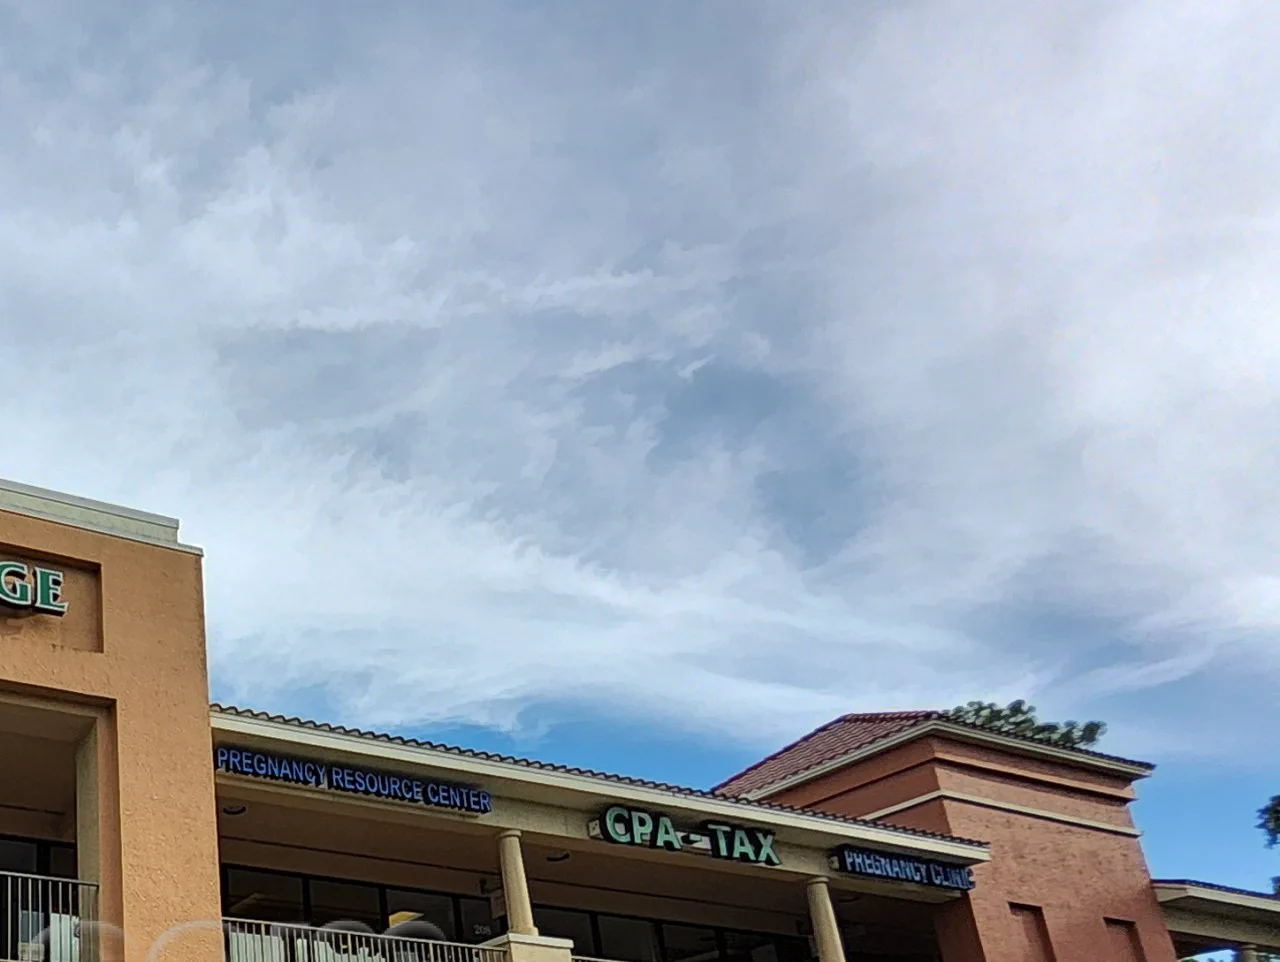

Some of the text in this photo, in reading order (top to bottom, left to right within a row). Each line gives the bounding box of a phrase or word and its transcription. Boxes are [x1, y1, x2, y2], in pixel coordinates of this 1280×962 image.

[217, 750, 493, 812] PREGNANCY RESOURCE CENTER
[843, 849, 975, 890] PREGNANCY CLINIC
